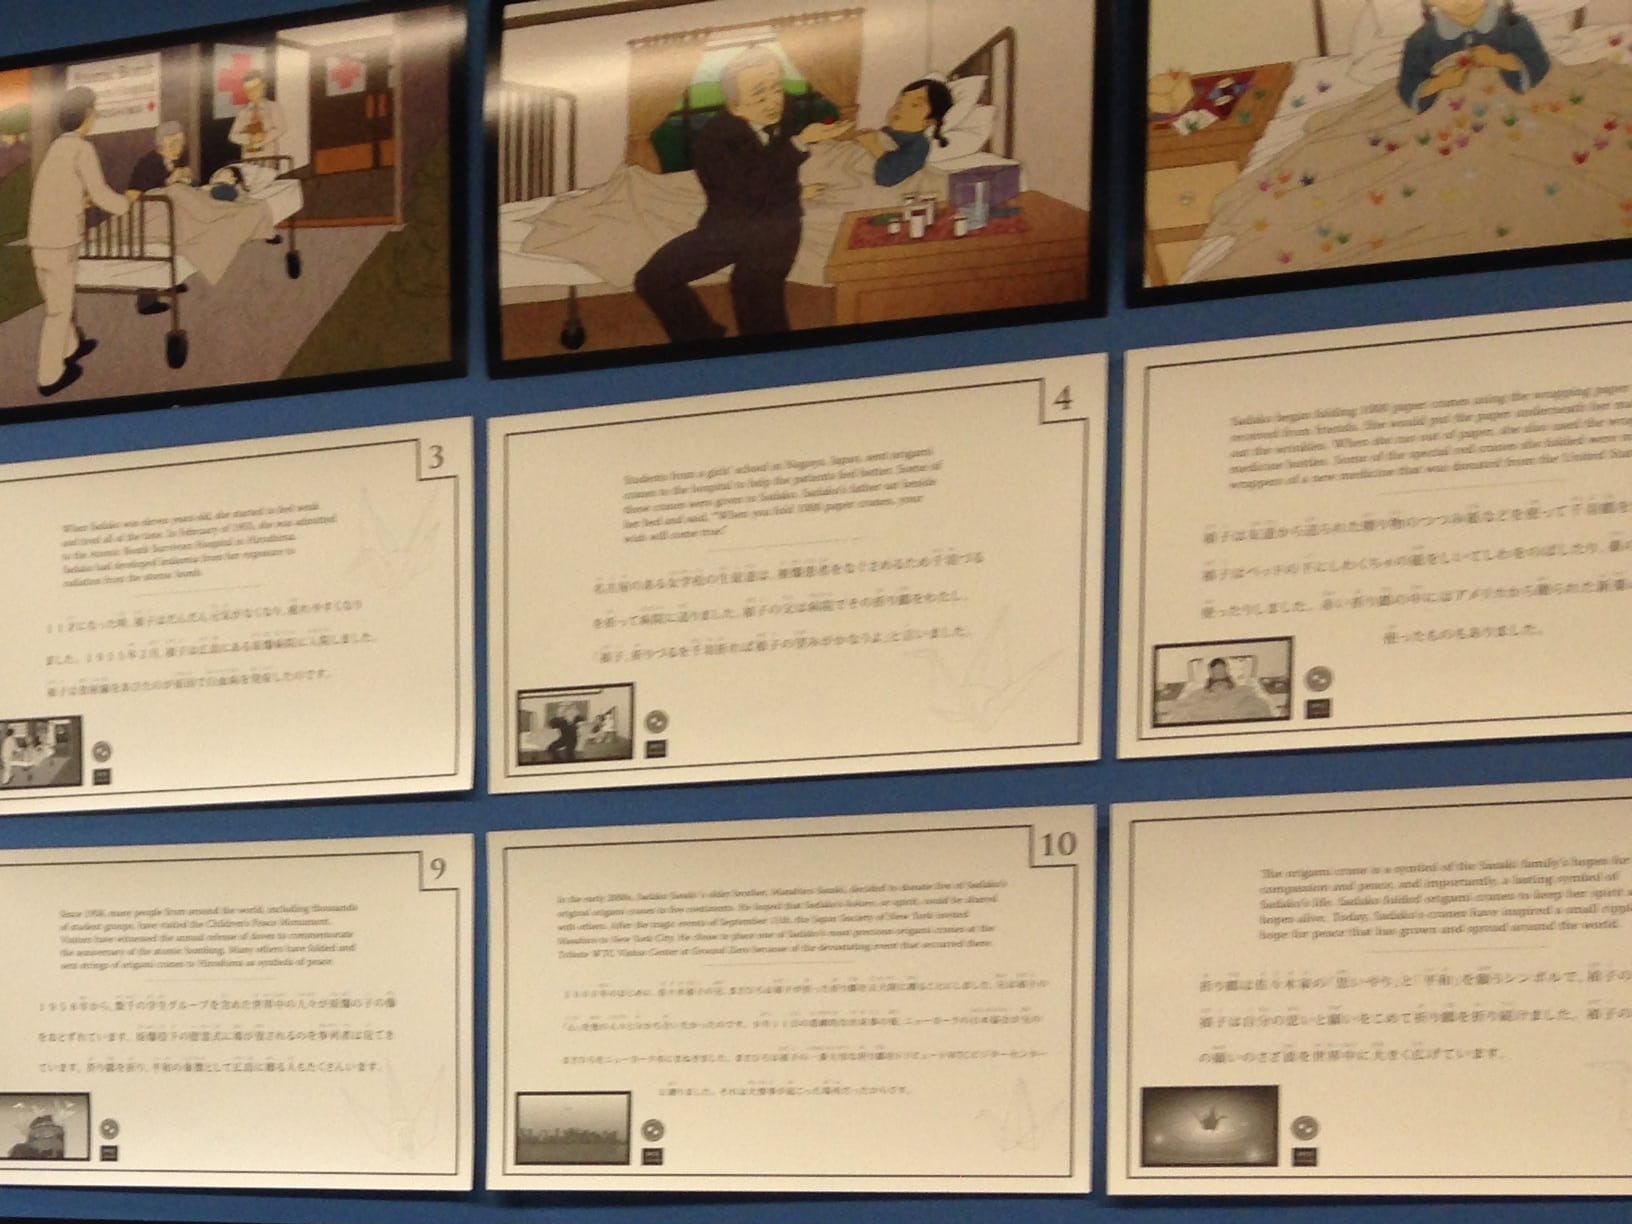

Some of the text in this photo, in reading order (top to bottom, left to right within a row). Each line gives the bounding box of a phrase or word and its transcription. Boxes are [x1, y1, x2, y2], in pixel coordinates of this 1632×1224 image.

[1054, 386, 1074, 410] 4
[429, 445, 445, 469] 3
[1040, 831, 1077, 857] 10
[430, 857, 447, 880] 9
